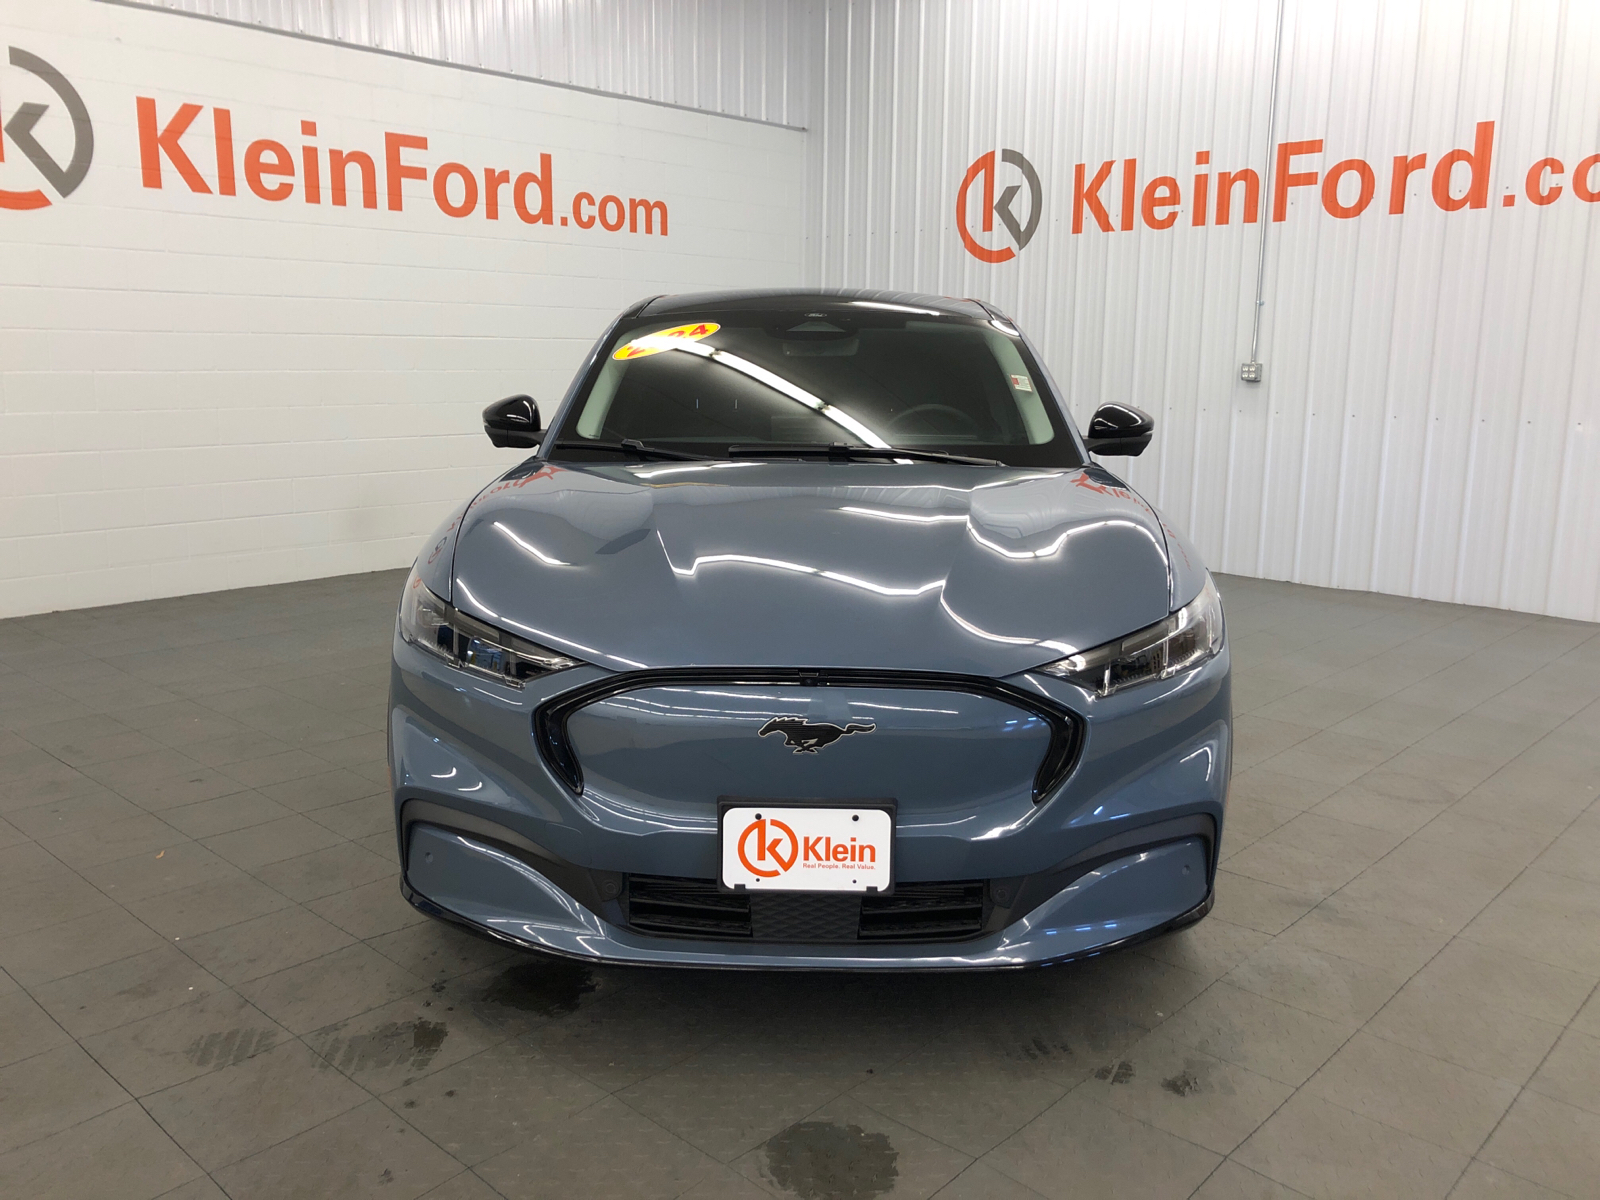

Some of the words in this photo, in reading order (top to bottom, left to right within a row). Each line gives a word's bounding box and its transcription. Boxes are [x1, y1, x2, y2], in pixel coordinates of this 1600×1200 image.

[136, 96, 669, 237] KleinFord.com
[803, 836, 876, 862] Klein
[818, 862, 840, 870] People.
[857, 863, 876, 871] Value.
